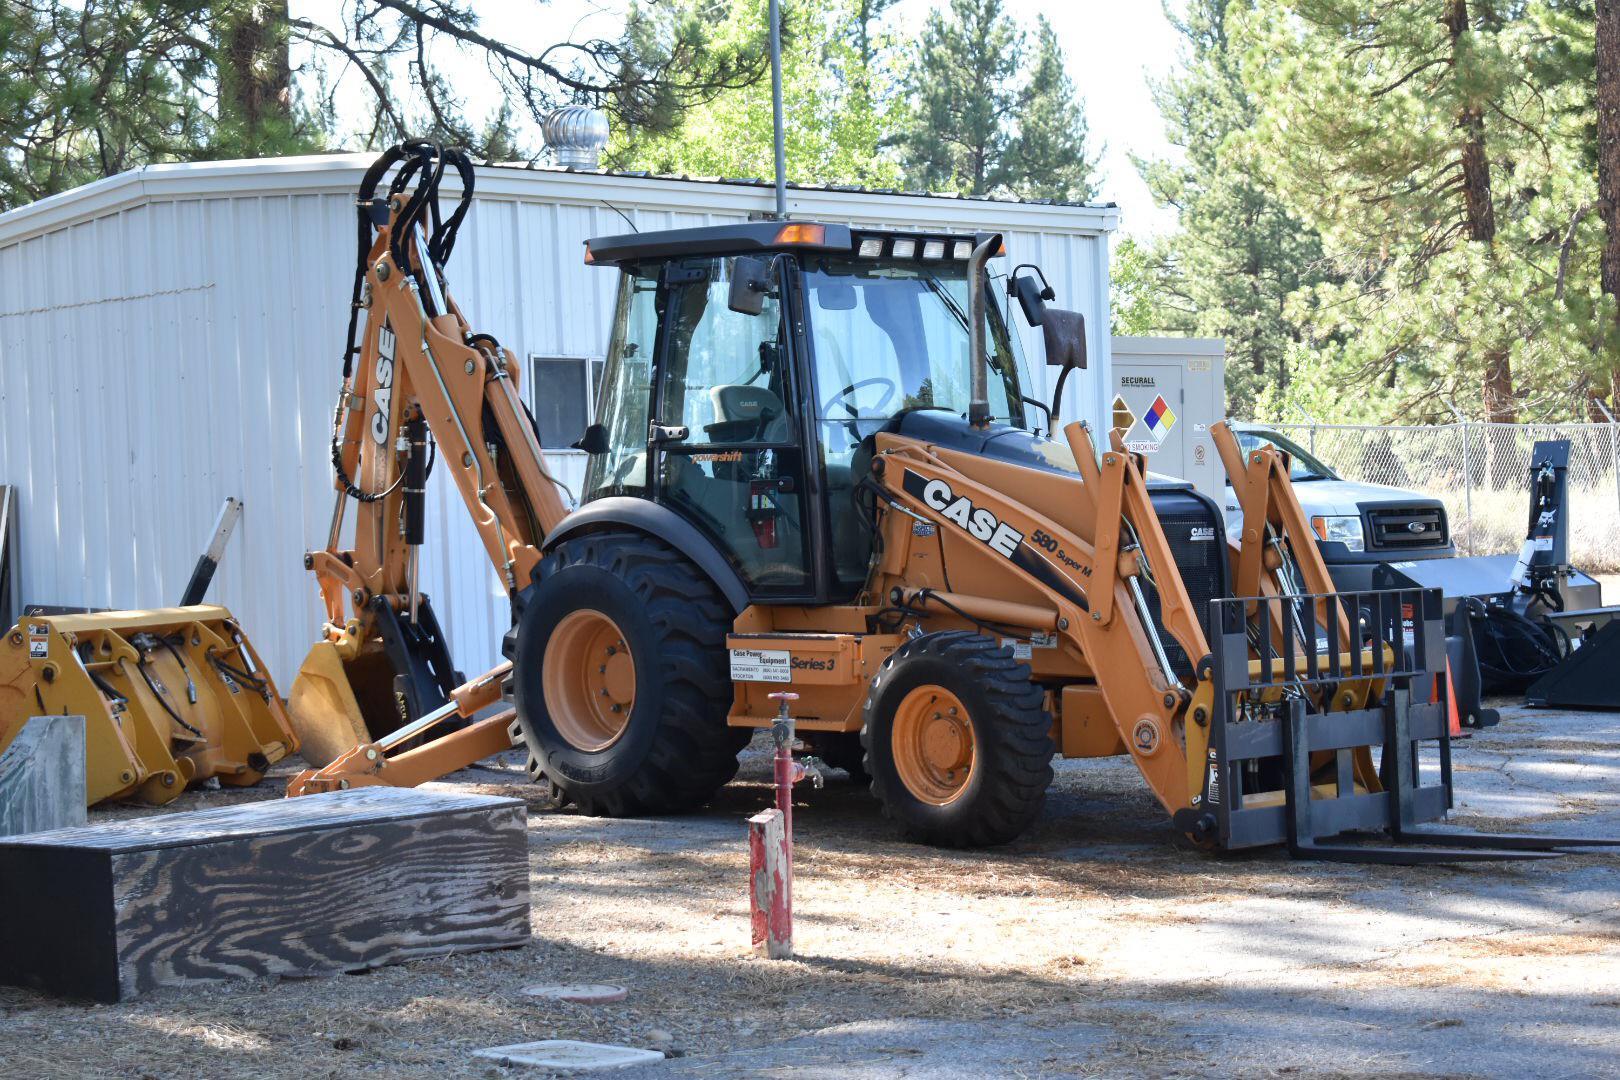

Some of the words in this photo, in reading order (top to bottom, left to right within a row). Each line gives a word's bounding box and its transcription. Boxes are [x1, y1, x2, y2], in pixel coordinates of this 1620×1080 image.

[371, 325, 396, 446] CASE
[1121, 376, 1155, 384] SECURALL
[691, 451, 742, 464] powershift
[923, 479, 1025, 559] CASE
[1191, 527, 1214, 537] CASE
[1031, 529, 1058, 553] 580
[1056, 549, 1082, 570] Super
[1082, 566, 1092, 577] M
[733, 649, 746, 657] Case
[746, 650, 762, 658] Power
[760, 656, 787, 666] Equipment
[791, 657, 826, 670] Series
[826, 658, 835, 671] 3
